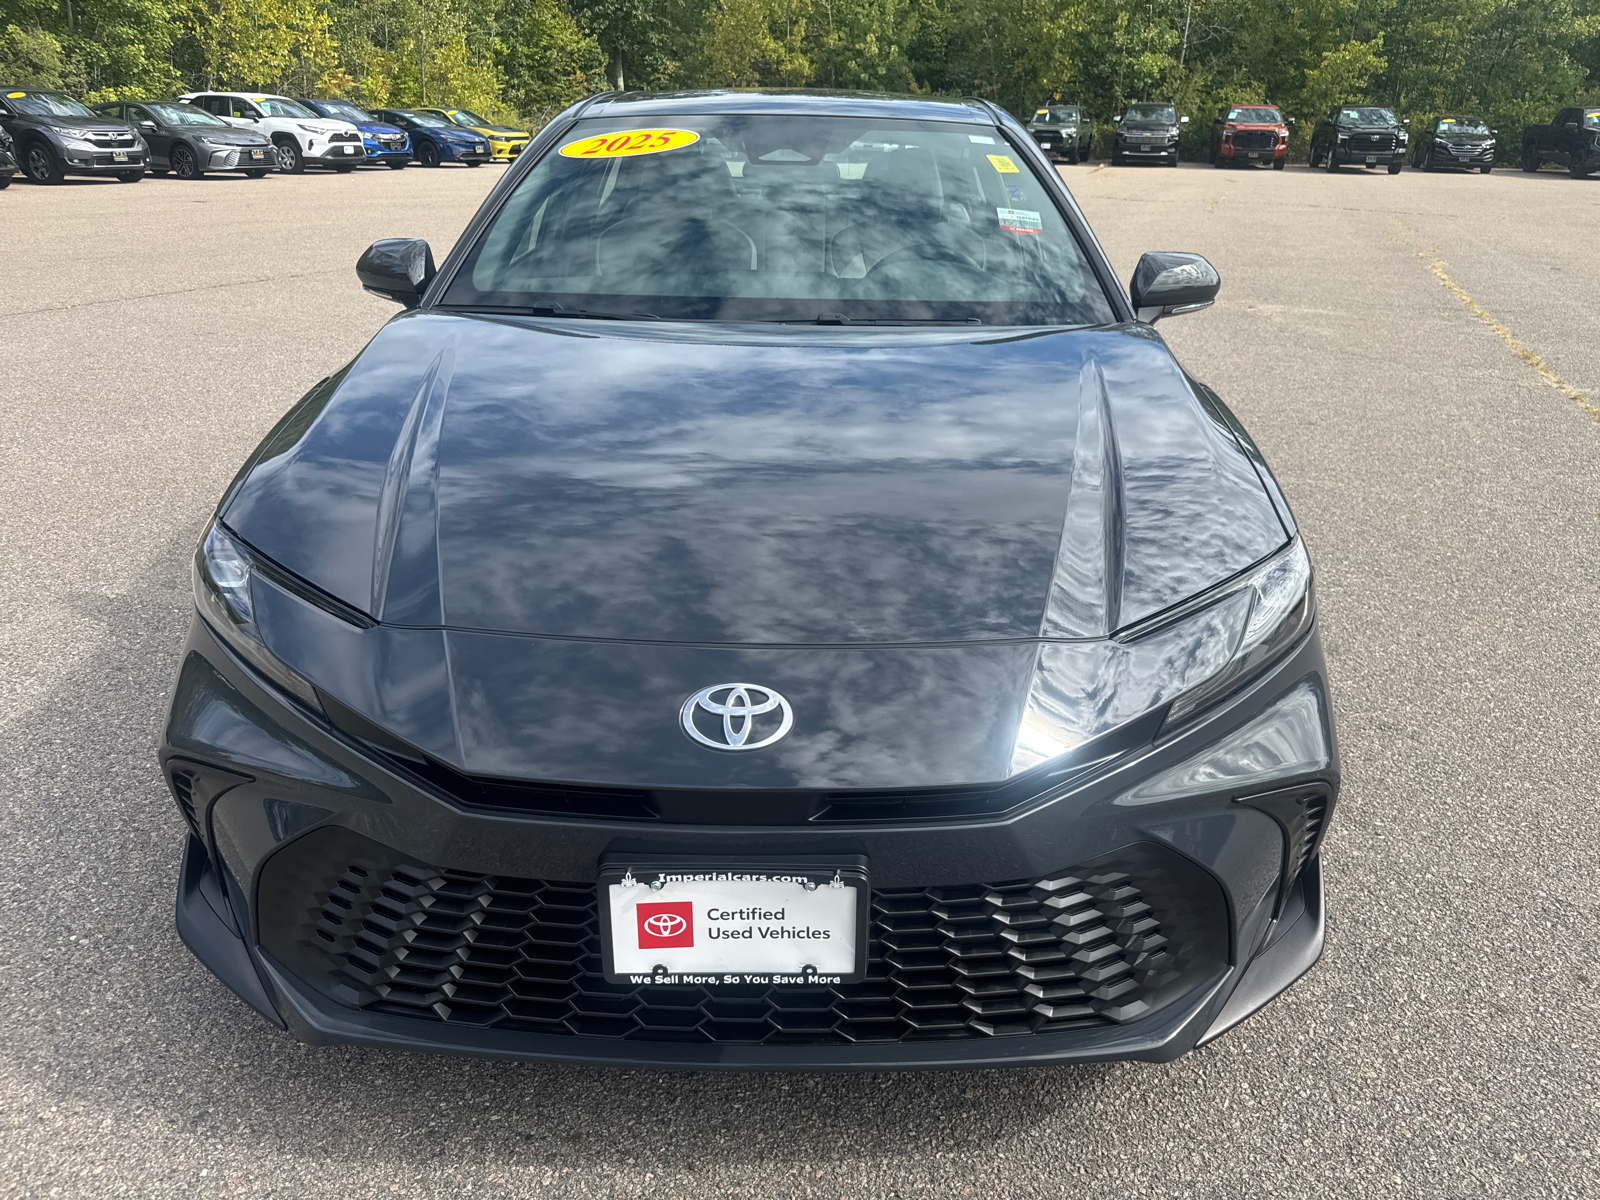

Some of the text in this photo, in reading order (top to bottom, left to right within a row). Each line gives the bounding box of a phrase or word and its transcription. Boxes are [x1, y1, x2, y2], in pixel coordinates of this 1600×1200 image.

[581, 132, 677, 155] 2025
[658, 873, 808, 884] Imperialcars.com
[707, 907, 785, 921] Certified
[708, 926, 831, 940] Used Vehicles
[630, 975, 841, 985] We Sell More, So You Save More
